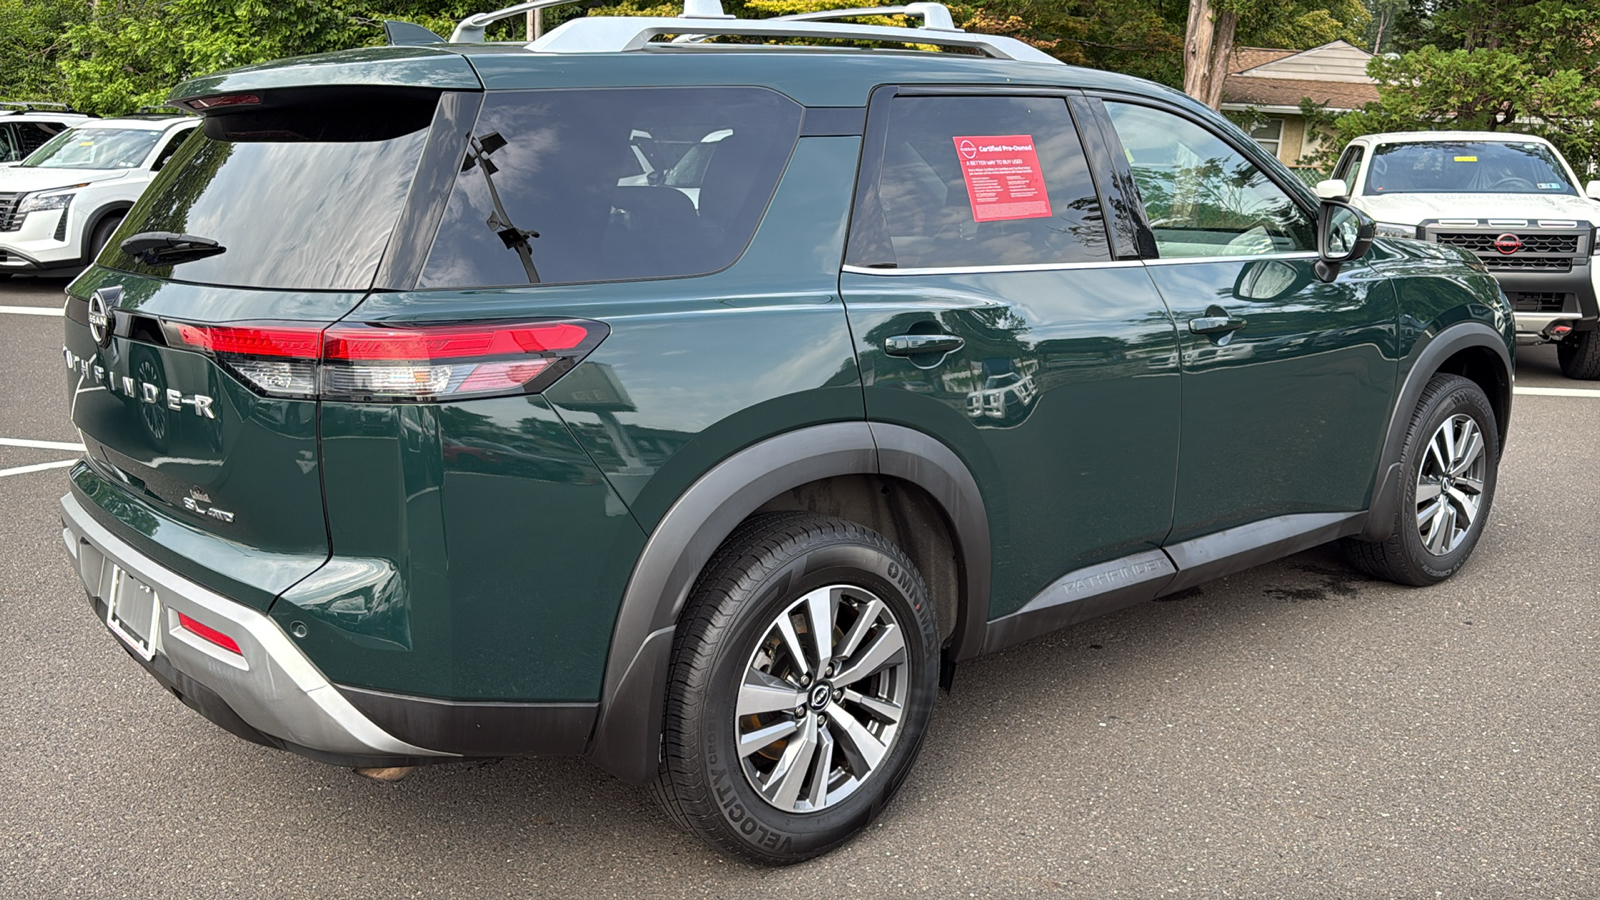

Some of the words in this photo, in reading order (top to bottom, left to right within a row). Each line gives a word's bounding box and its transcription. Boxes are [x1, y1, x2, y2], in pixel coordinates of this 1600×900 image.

[1002, 144, 1032, 152] Pre-Owned
[183, 496, 207, 515] SL
[1061, 557, 1169, 594] PATHFINDER
[887, 561, 938, 660] OMNIMAX
[710, 766, 793, 850] VELOCITY
